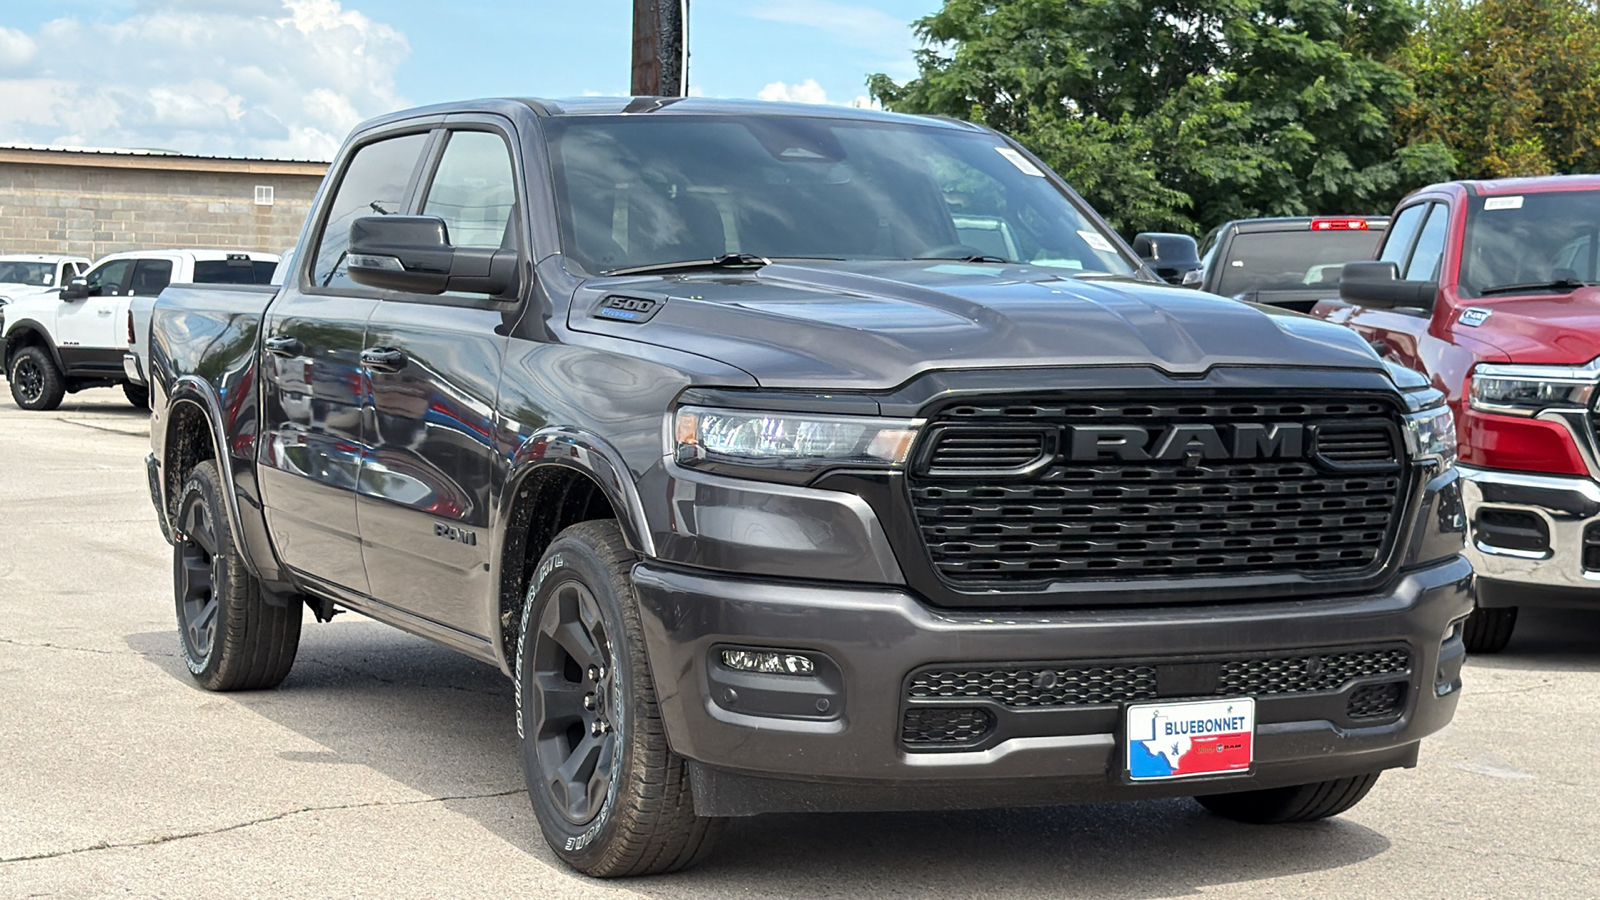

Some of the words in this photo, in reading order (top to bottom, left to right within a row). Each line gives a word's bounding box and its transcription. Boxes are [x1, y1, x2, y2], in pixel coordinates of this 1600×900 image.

[606, 297, 654, 312] 1500
[1070, 423, 1304, 461] RAM
[433, 521, 477, 546] RAM
[1165, 716, 1245, 735] BLUEBONNET
